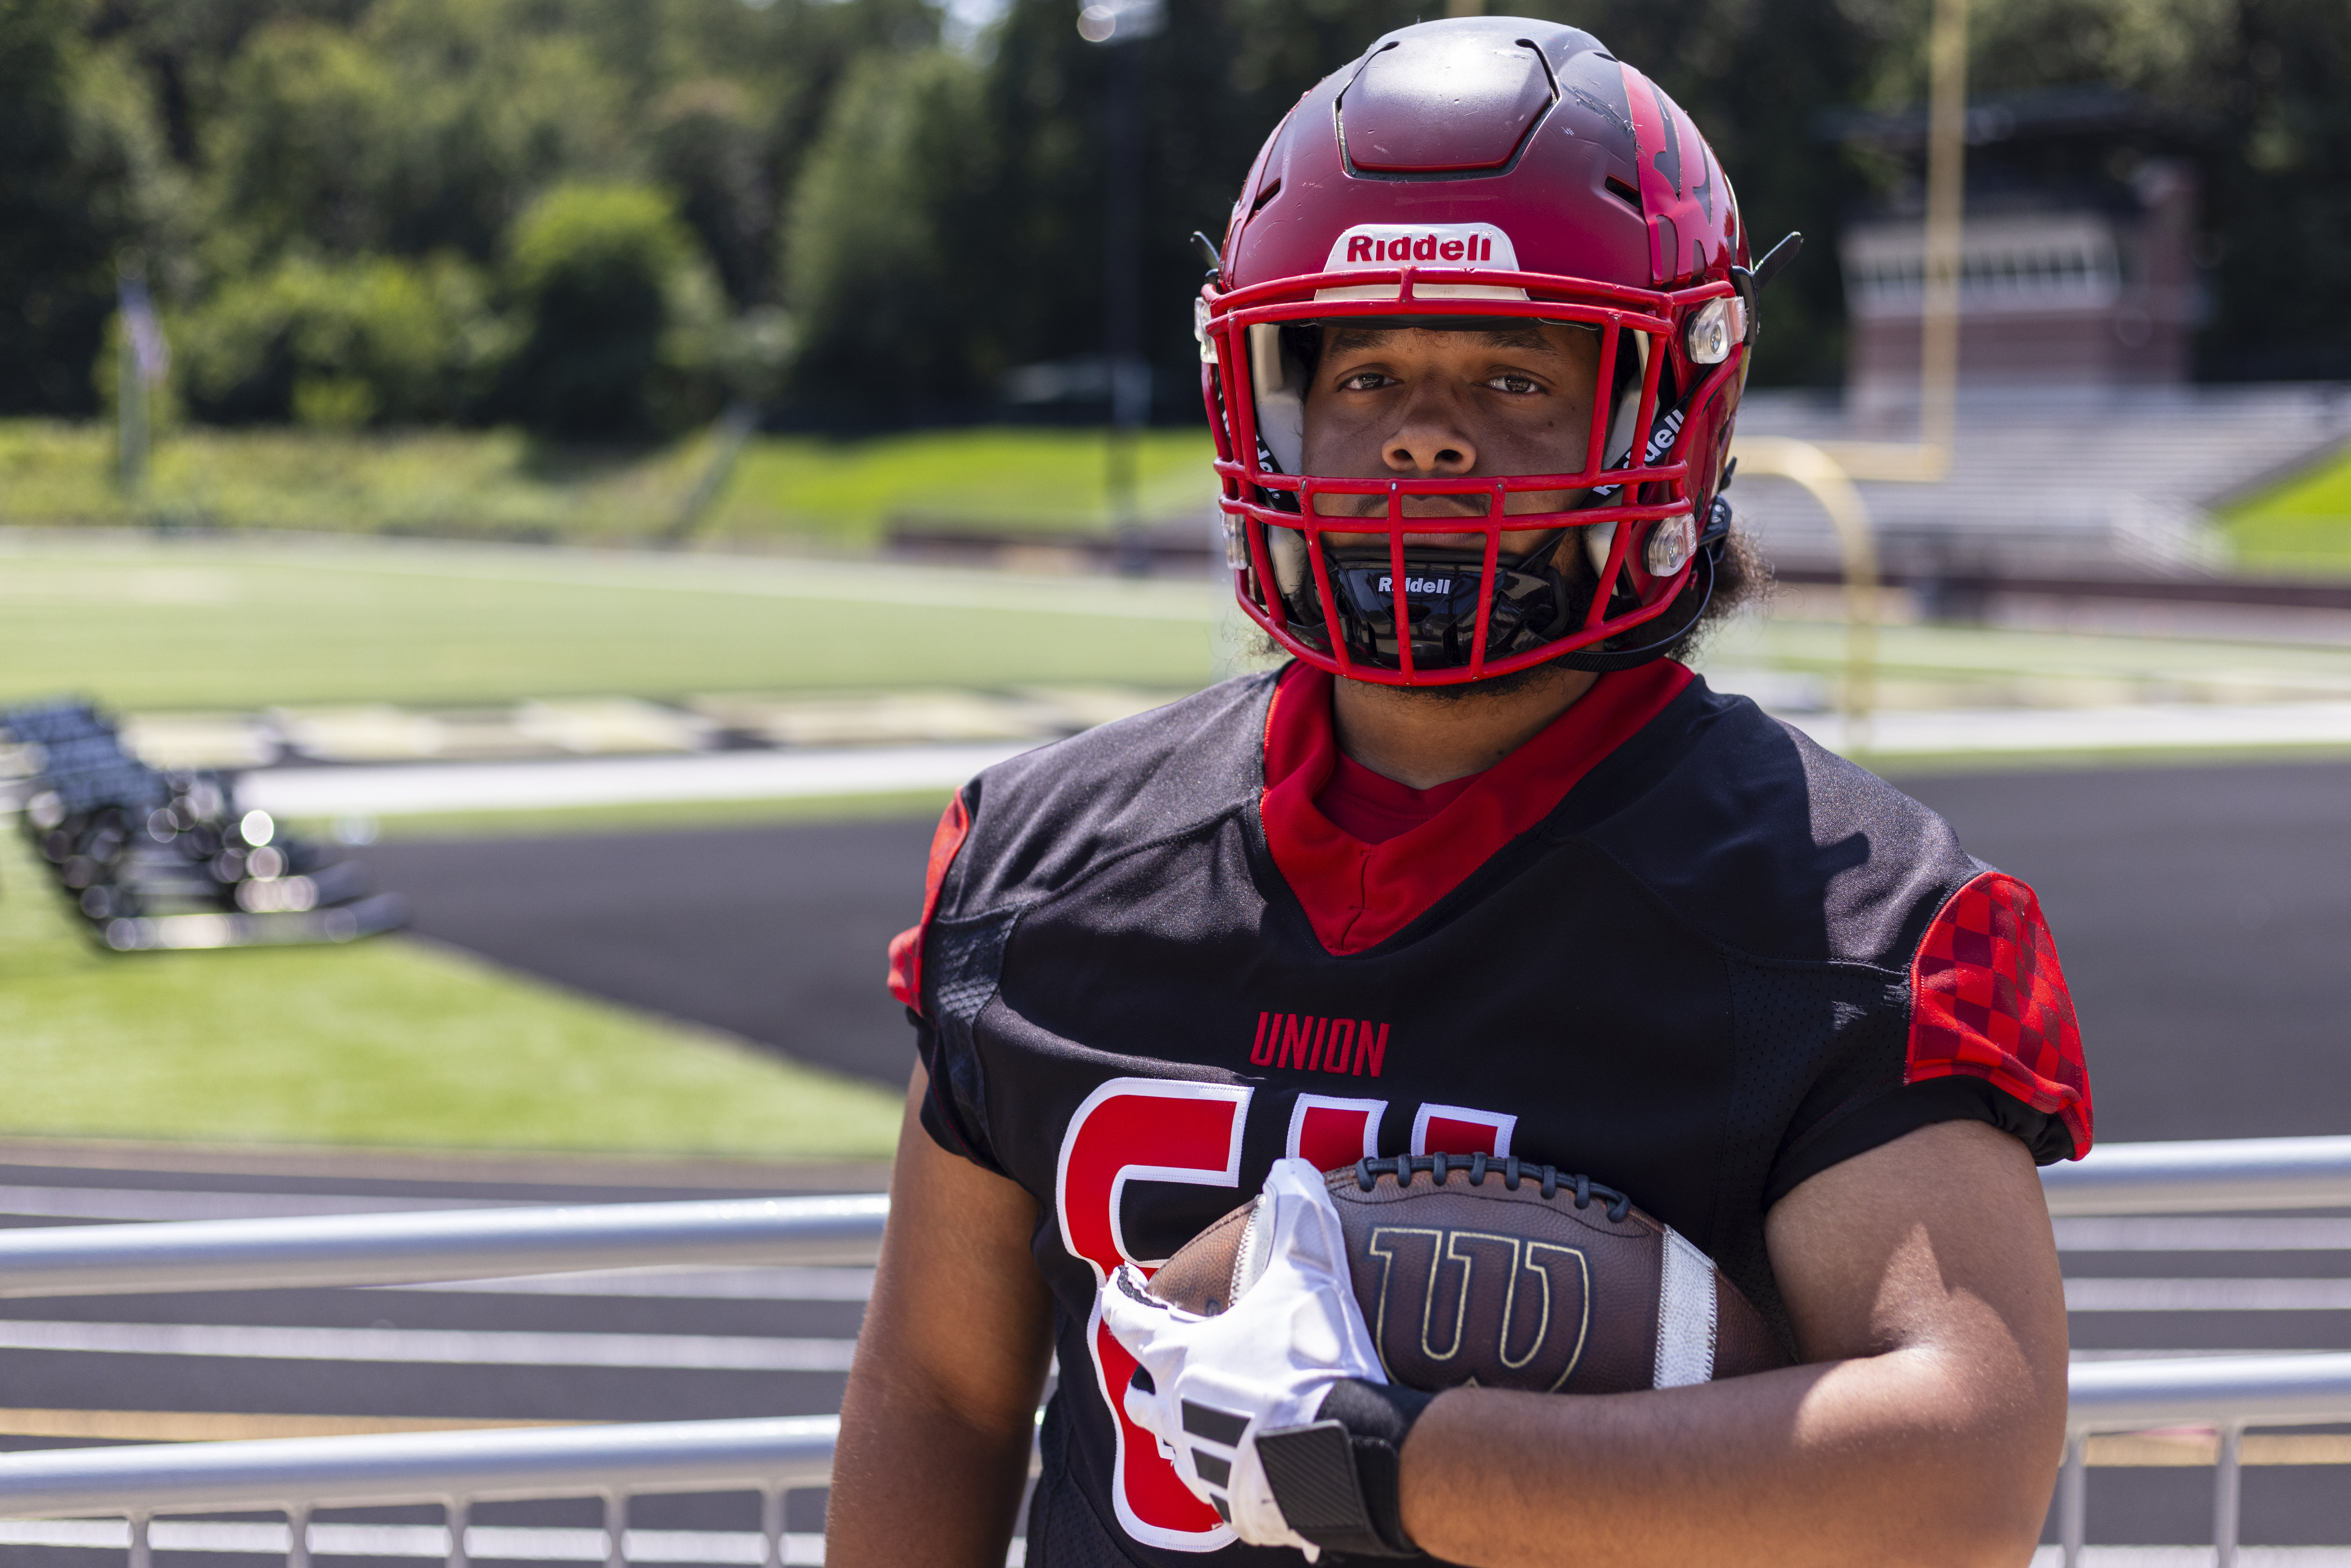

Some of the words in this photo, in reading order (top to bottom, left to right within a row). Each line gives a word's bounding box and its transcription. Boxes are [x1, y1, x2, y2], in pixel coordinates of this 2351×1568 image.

[1346, 232, 1492, 262] Riddell
[1250, 1011, 1392, 1077] UNION
[1057, 1077, 1517, 1552] 6
